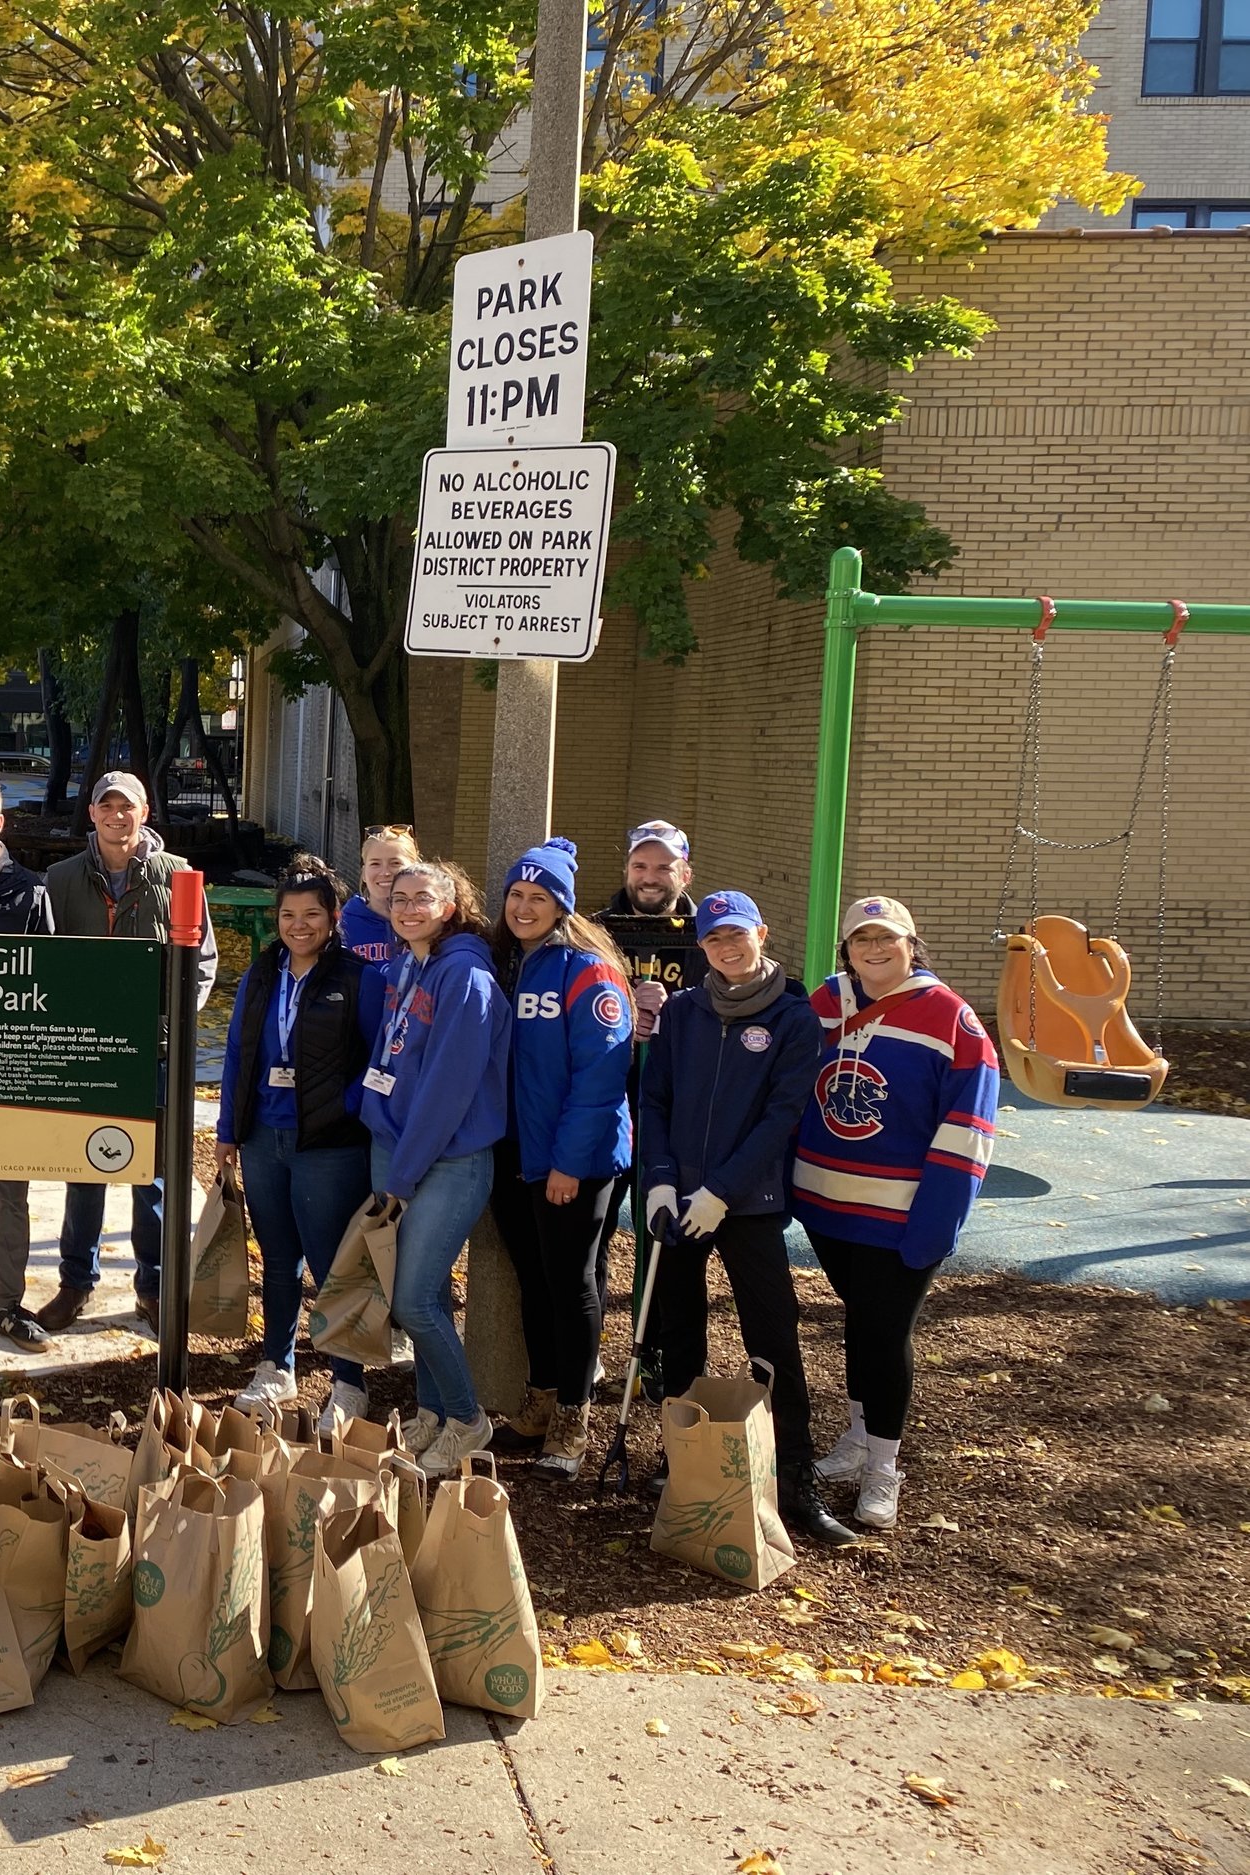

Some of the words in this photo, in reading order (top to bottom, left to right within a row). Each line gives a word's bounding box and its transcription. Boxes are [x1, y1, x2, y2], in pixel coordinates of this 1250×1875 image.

[477, 271, 563, 320] PARK
[457, 321, 579, 371] CLOSES
[467, 373, 560, 426] 11:PM
[439, 473, 464, 492] NO
[473, 470, 590, 491] ALCOHOLIC
[451, 499, 573, 519] BEVERAGES
[424, 531, 502, 549] ALLOWED
[508, 531, 533, 549] ON
[541, 530, 593, 550] PARK
[422, 557, 496, 576] DISTRICT
[500, 557, 589, 577] PROPERTY
[465, 594, 541, 609] VIOLATORS
[422, 614, 488, 630] SUBJECT
[495, 616, 514, 630] TO
[518, 616, 581, 633] ARREST
[521, 866, 543, 883] W
[517, 991, 561, 1019] BS
[4, 1032, 21, 1041] keep
[37, 1033, 77, 1043] playground
[77, 1026, 96, 1035] 11pm
[23, 1042, 41, 1050] safe,
[43, 1042, 66, 1052] please
[97, 1045, 117, 1053] these
[118, 1046, 139, 1054] rules:
[490, 1672, 525, 1685] WHOLE
[491, 1682, 524, 1694] FOODS
[374, 1699, 391, 1710] food
[392, 1686, 426, 1704] standards
[379, 1681, 417, 1699] Pioneering
[383, 1704, 401, 1715] since
